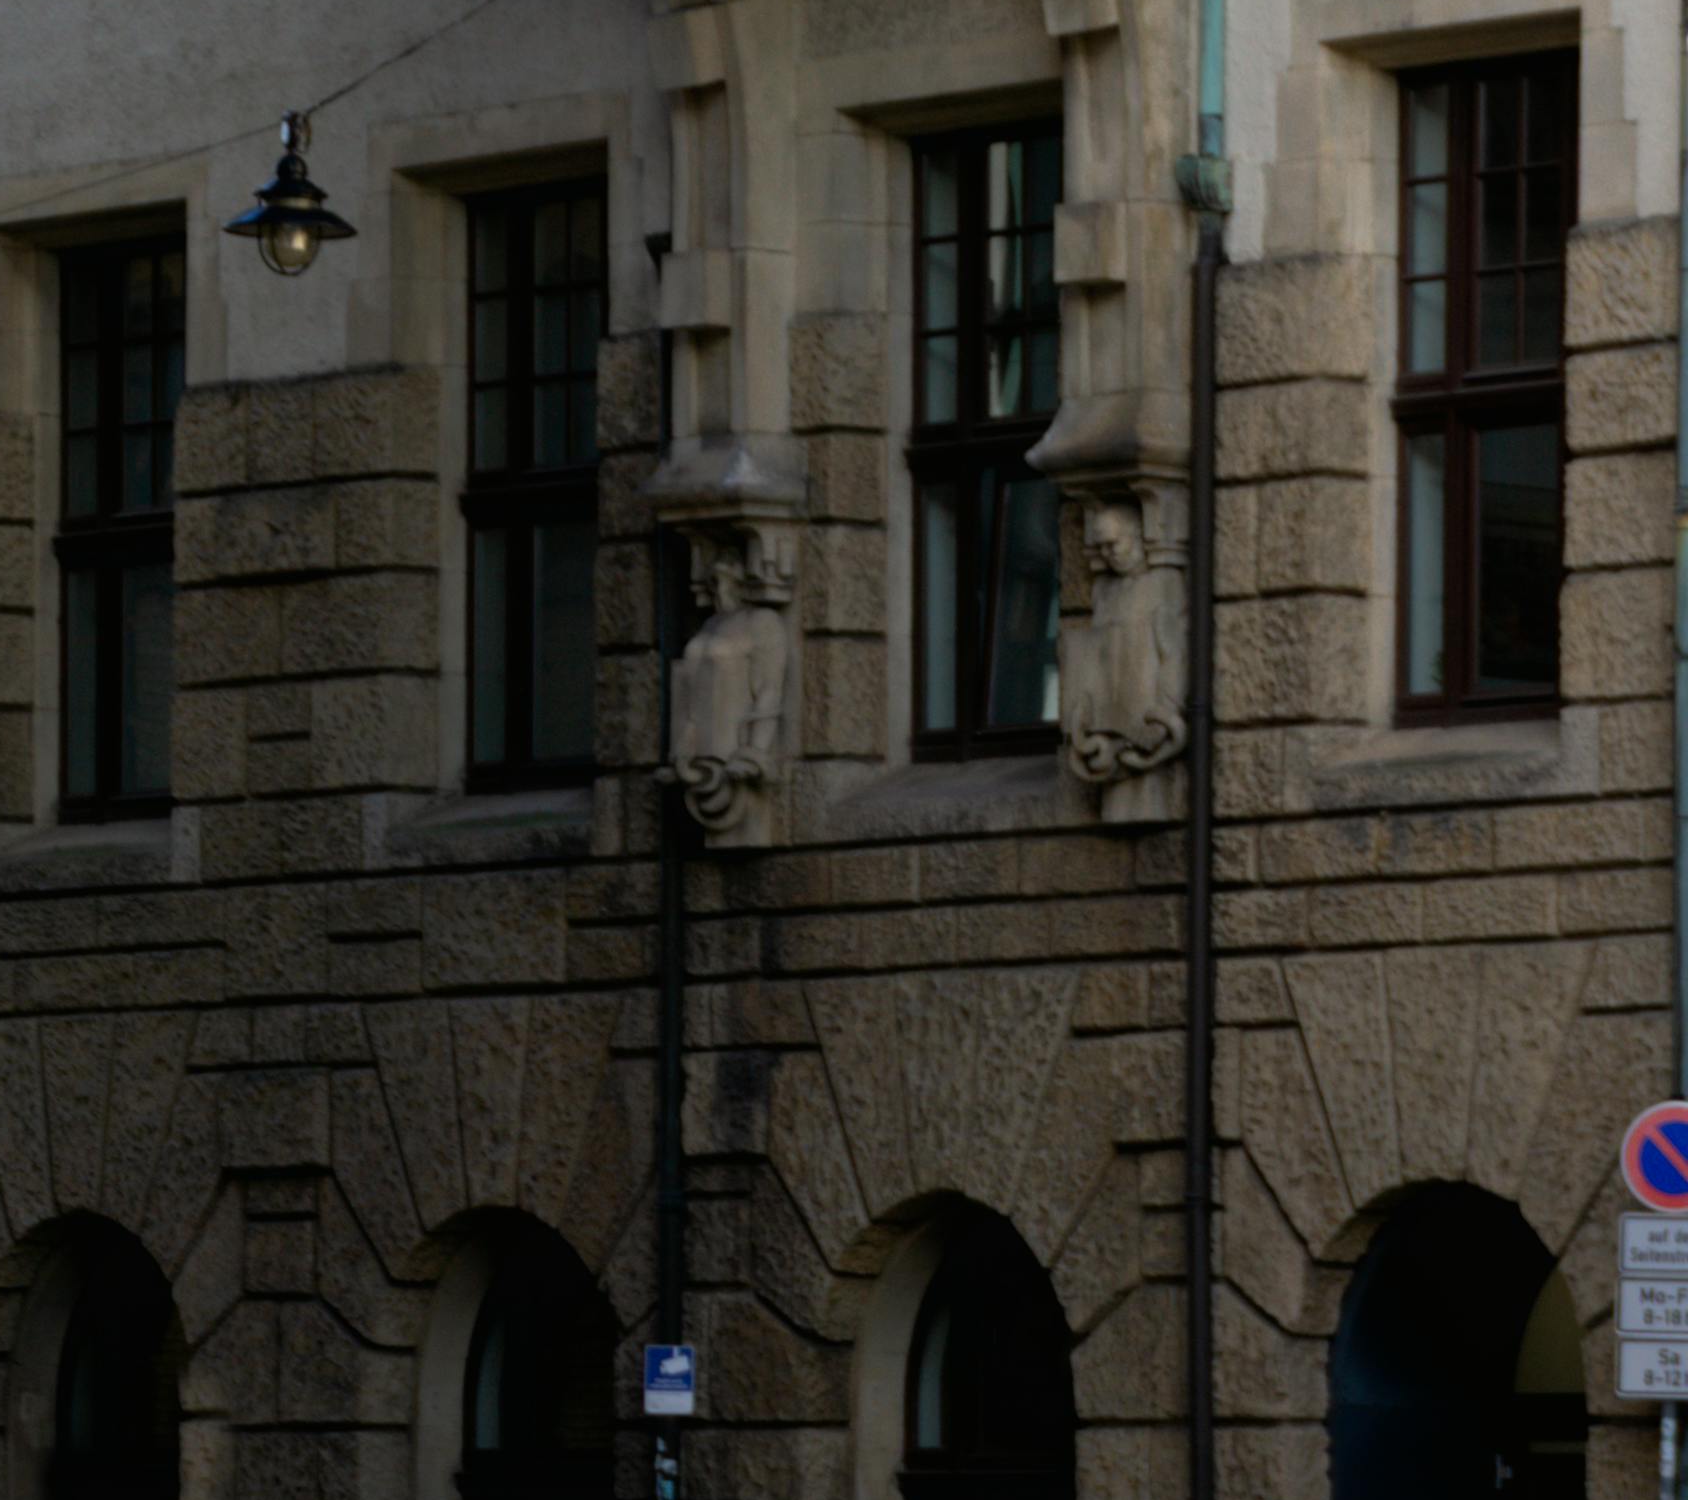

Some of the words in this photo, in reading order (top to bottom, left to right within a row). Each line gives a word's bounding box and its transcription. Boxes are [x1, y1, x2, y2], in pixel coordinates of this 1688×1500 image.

[1647, 1228, 1670, 1243] auf
[1630, 1245, 1688, 1263] Seitenstr
[1658, 1347, 1681, 1366] Sa
